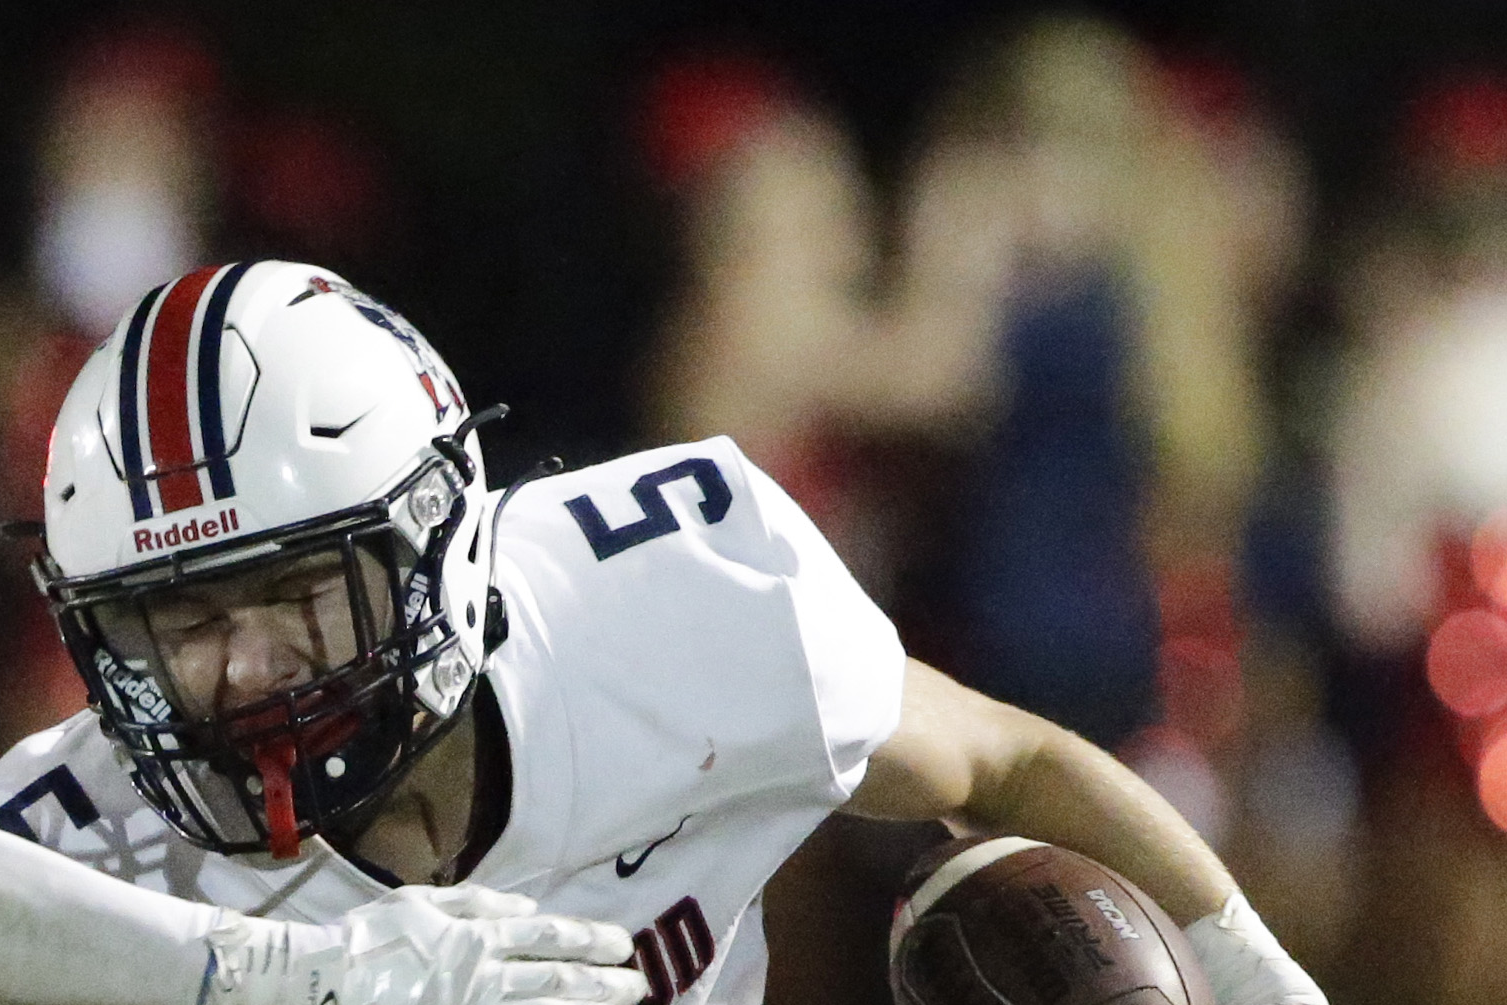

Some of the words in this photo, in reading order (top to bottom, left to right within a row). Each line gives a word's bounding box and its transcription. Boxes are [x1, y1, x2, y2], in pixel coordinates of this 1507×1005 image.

[132, 508, 240, 553] Riddell
[564, 458, 733, 562] 5
[1086, 889, 1141, 939] NCAA
